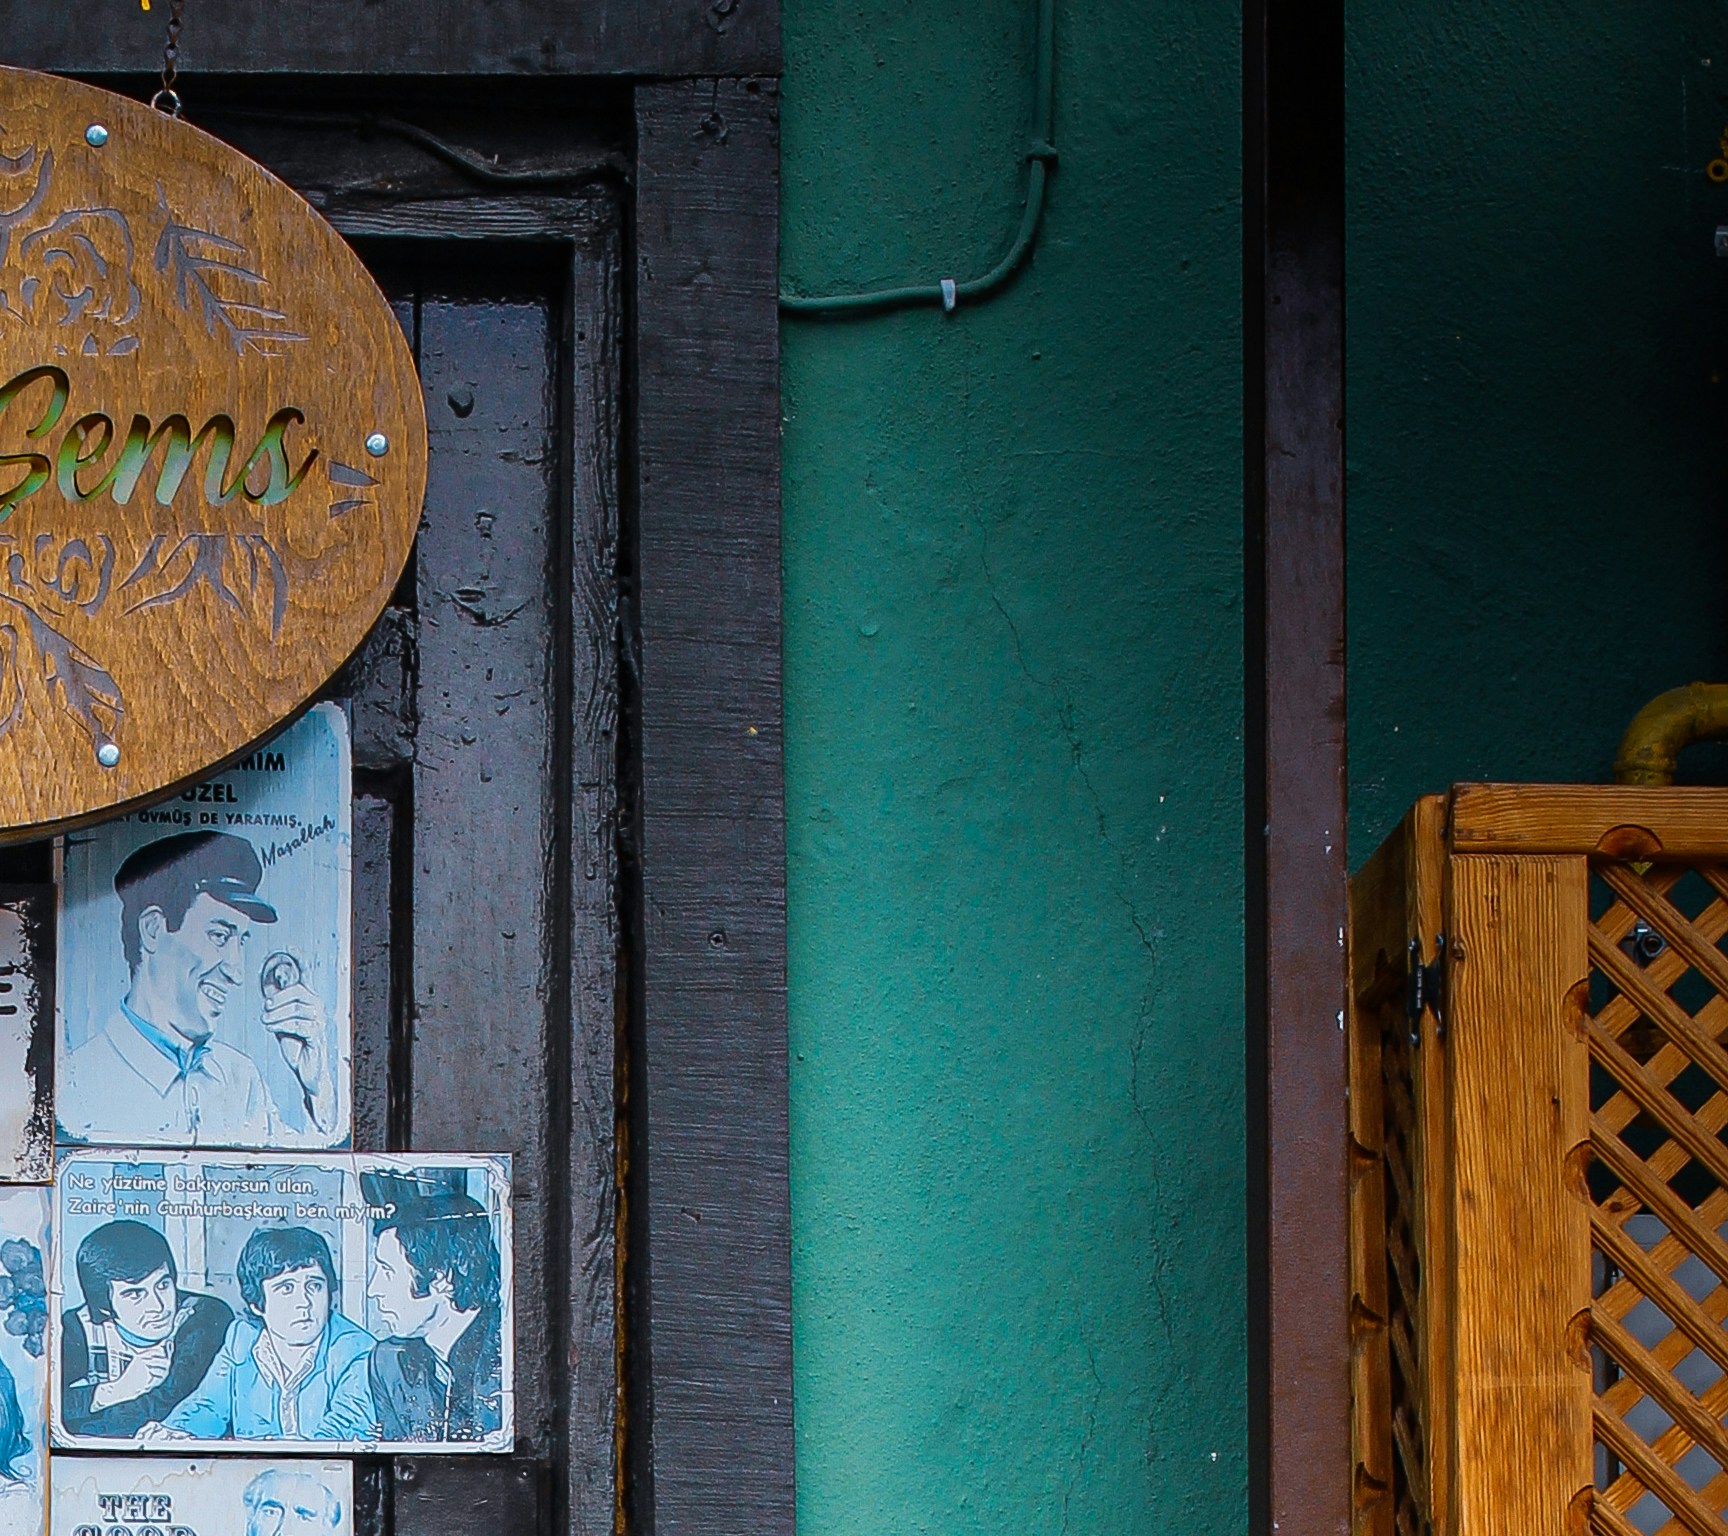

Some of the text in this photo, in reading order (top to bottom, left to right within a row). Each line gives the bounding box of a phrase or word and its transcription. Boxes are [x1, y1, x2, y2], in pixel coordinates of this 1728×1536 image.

[200, 813, 219, 825] DE
[260, 815, 336, 869] Maşallah
[68, 1173, 319, 1197] Ne yüzüme bakıyorsun ulan,
[68, 1198, 396, 1223] Zaire'nin Cumhurbaşkanı ben miyim?
[98, 1493, 172, 1523] THE
